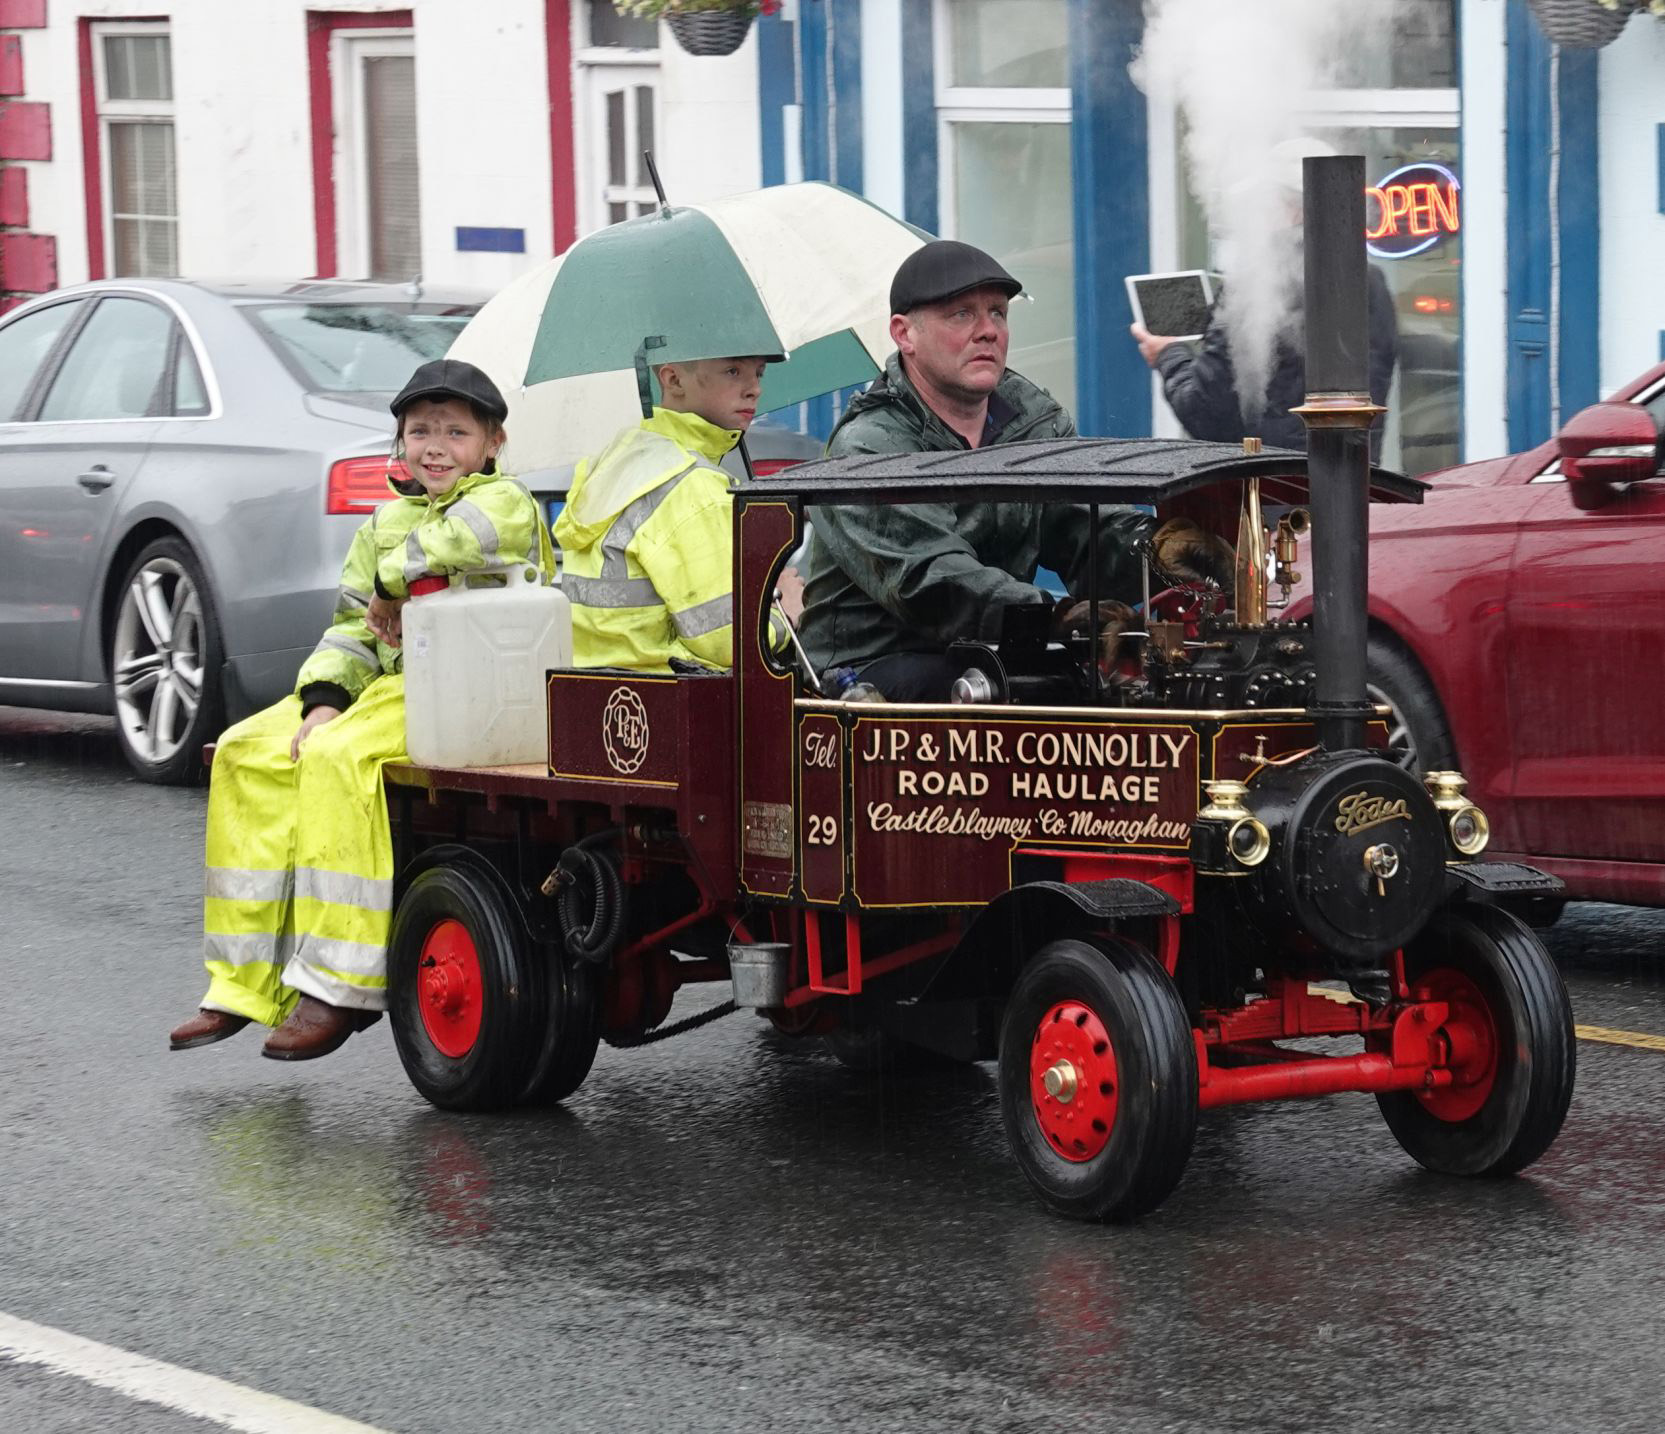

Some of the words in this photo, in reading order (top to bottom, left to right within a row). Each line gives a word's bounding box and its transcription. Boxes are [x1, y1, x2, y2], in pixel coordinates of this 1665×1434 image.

[1365, 183, 1459, 238] OPEN
[805, 732, 837, 768] Tel.
[863, 728, 910, 761] J.P.
[916, 733, 940, 762] &
[948, 729, 1010, 763] M.R.
[1016, 731, 1191, 768] CONNOLLY
[899, 770, 989, 796] ROAD
[1012, 772, 1160, 802] HAULAGE
[808, 814, 837, 846] 29
[1039, 808, 1066, 834] Co.
[1068, 810, 1191, 844] Monaghan
[1335, 791, 1413, 836] Foden
